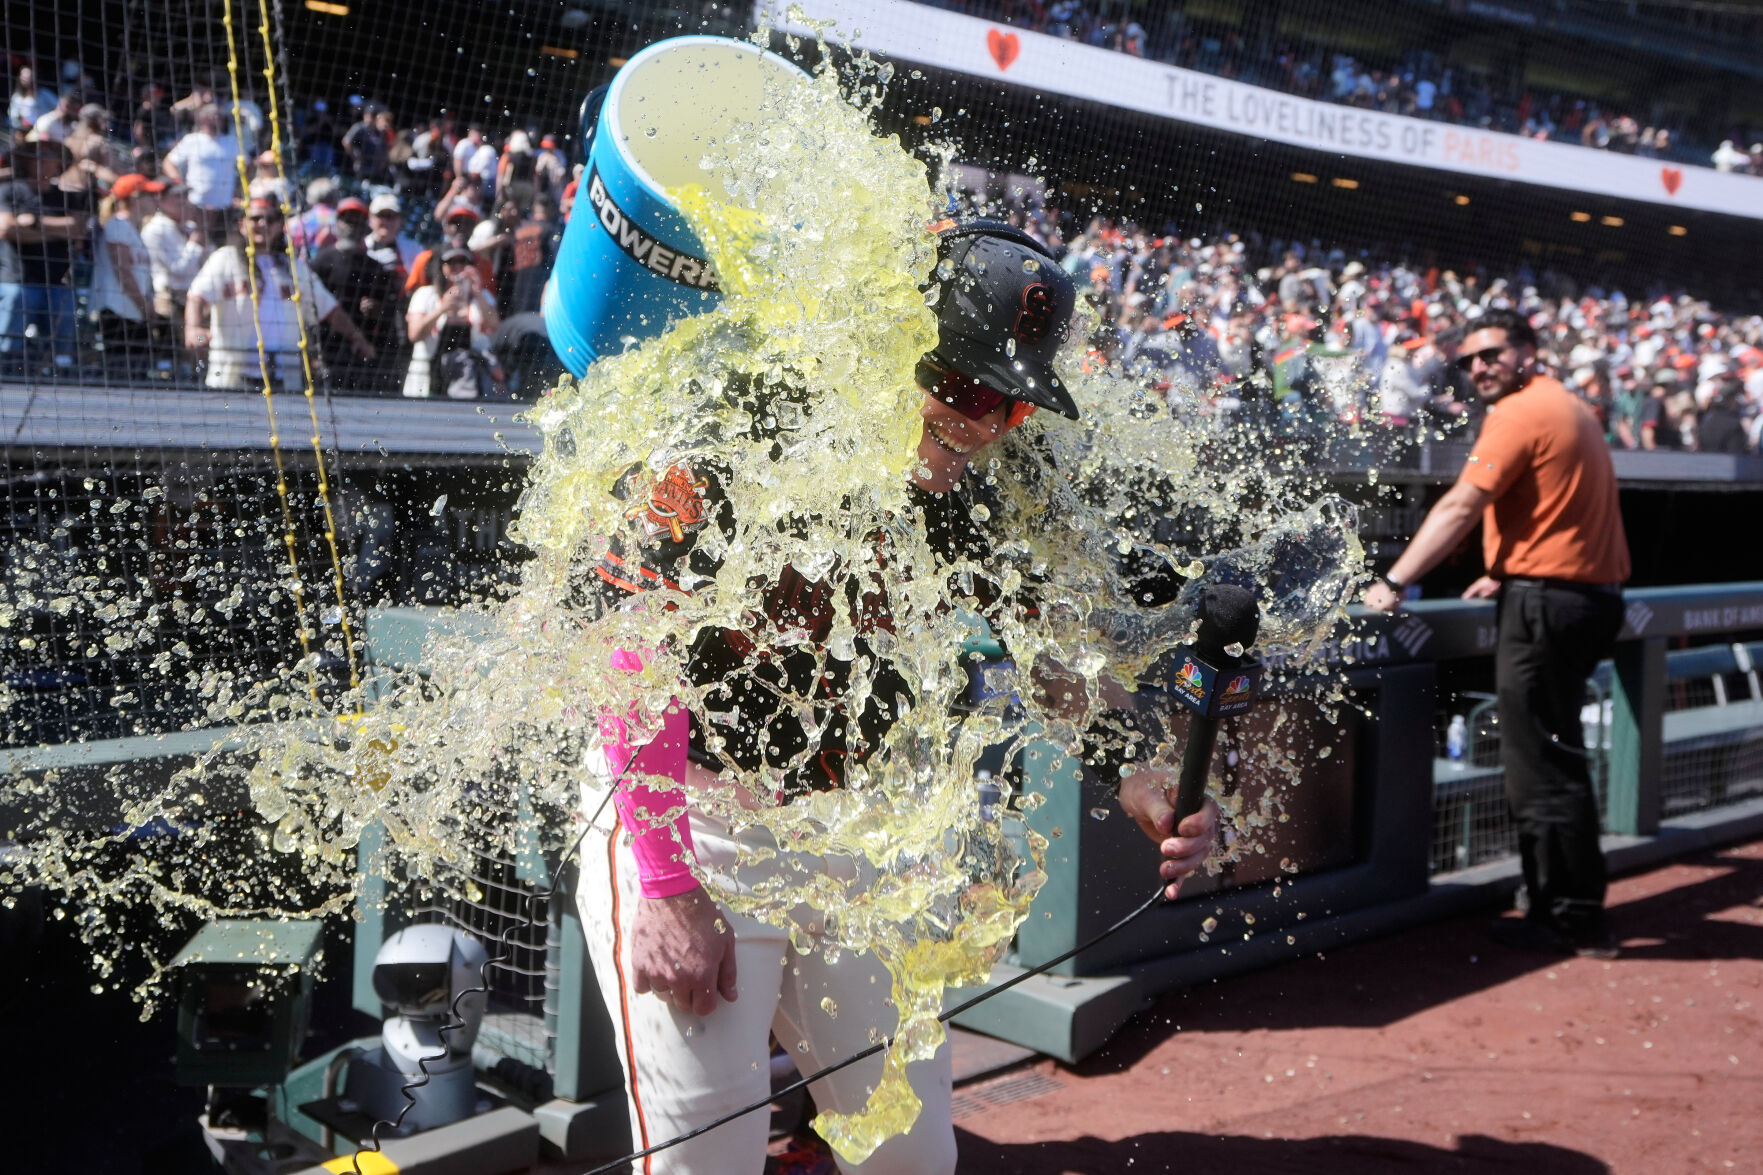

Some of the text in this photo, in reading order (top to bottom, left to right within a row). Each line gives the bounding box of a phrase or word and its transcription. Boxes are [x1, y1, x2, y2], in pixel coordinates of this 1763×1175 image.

[1166, 74, 1521, 172] THE LOVELINESS OF PARIS
[1683, 609, 1721, 630] BANK
[1723, 606, 1739, 627] OF
[1174, 685, 1201, 706] BAY AREA
[1219, 704, 1233, 712] BAY
